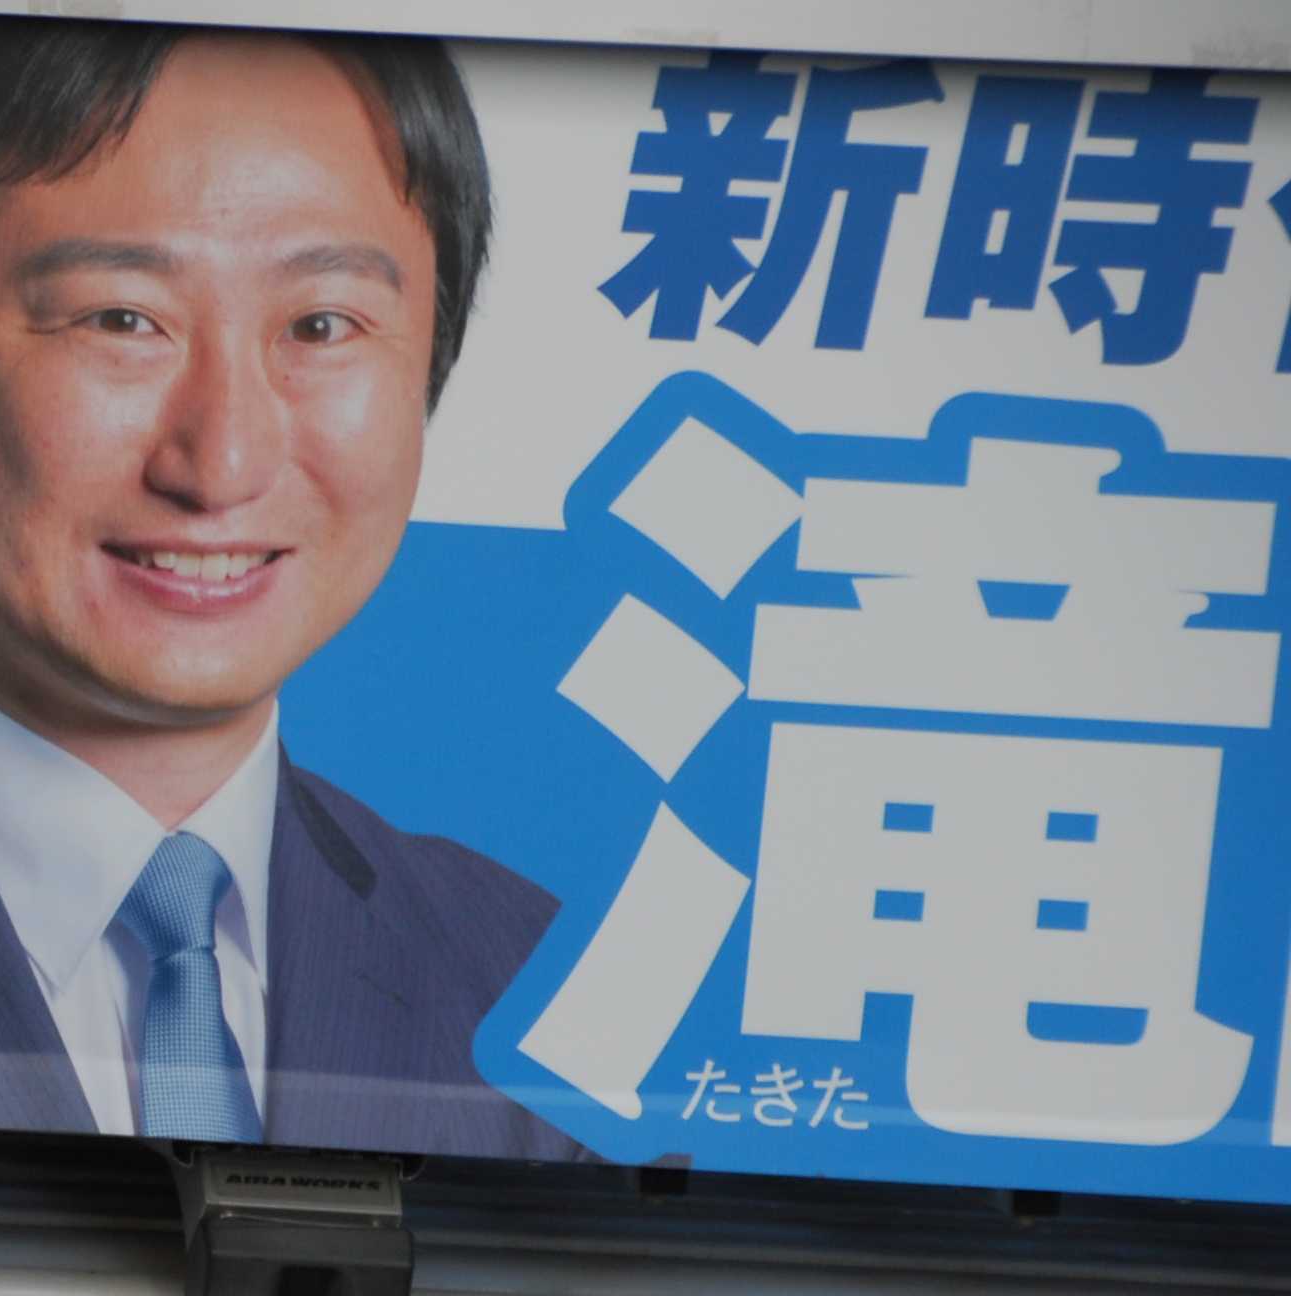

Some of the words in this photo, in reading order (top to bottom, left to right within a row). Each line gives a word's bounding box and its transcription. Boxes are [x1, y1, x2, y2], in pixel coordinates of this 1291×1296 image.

[598, 49, 1291, 374] 新時
[517, 415, 1291, 1145] 滝
[681, 1059, 868, 1130] たきた
